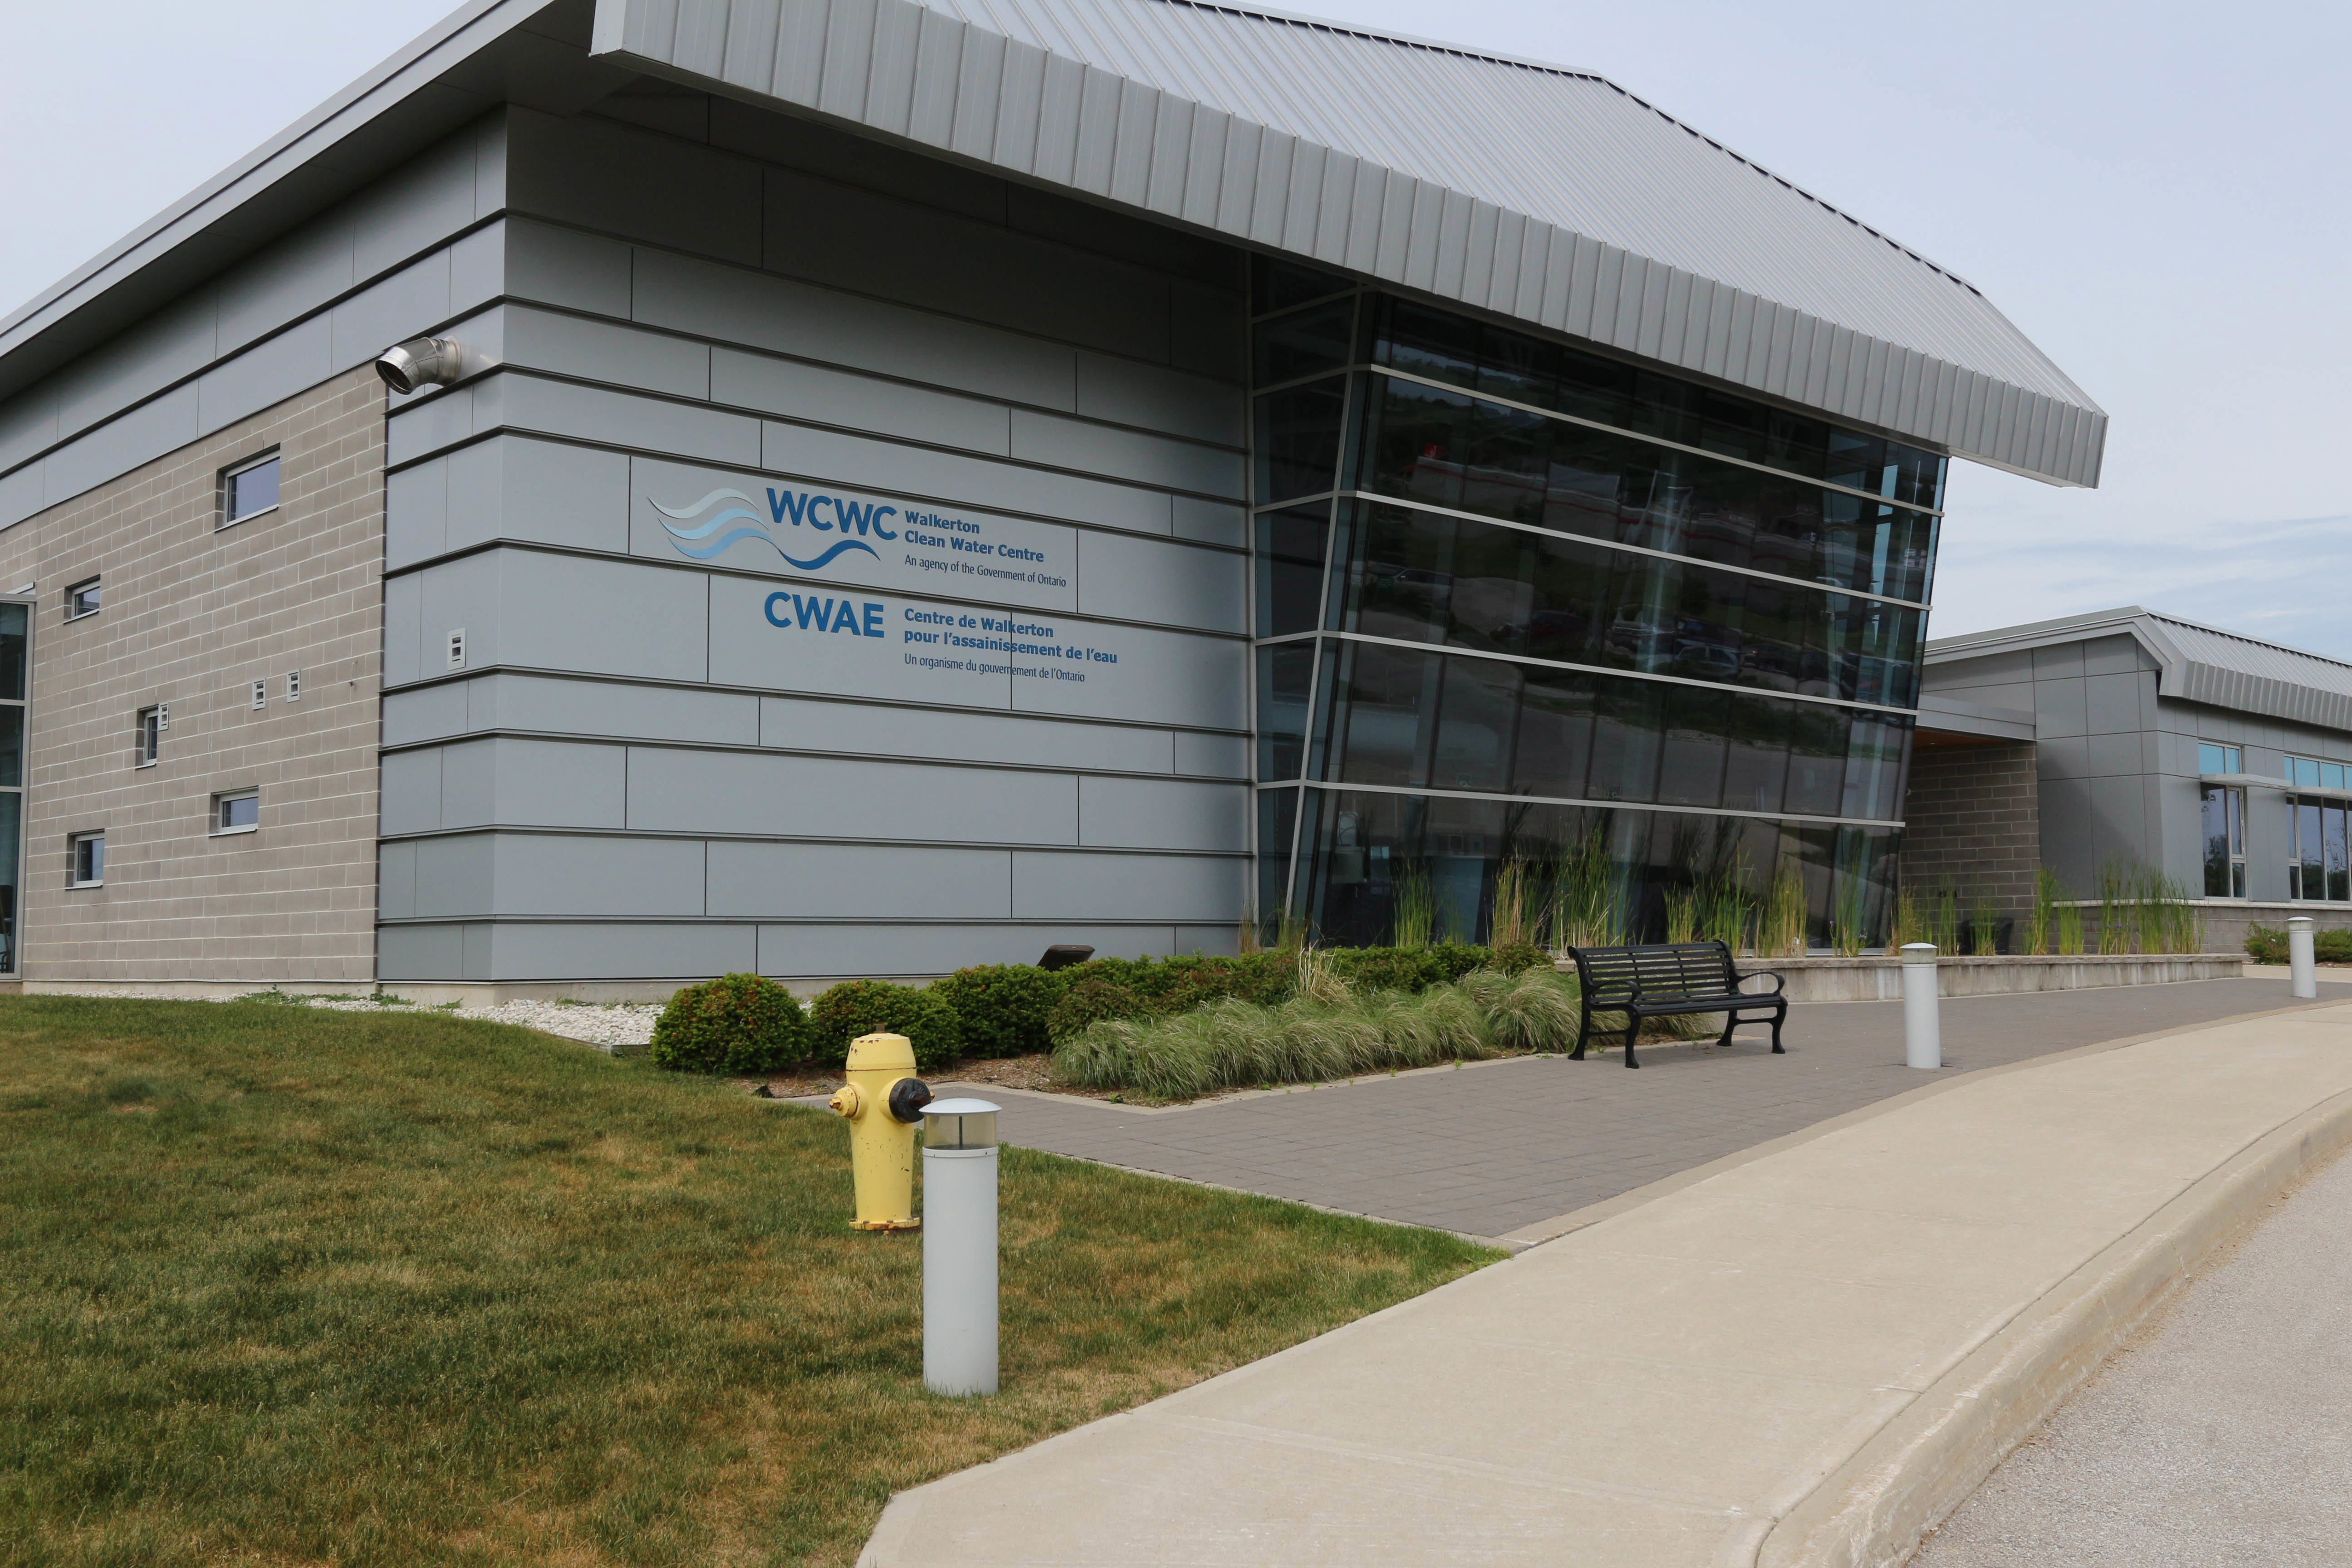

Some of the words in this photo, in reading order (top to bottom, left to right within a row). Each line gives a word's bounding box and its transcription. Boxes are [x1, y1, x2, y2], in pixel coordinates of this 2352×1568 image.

[766, 488, 897, 540] WCWC
[905, 510, 980, 534] Walkerton
[905, 530, 945, 547] Clean
[951, 537, 994, 554] Water
[998, 544, 1044, 562] Centre
[905, 554, 916, 566] An
[919, 558, 948, 573] agency
[951, 561, 960, 572] of
[962, 563, 975, 574] the
[977, 565, 1025, 582] Government
[1028, 572, 1036, 583] of
[1038, 574, 1066, 587] Ontario
[764, 592, 884, 638] CWAE
[905, 608, 954, 626] Centre
[959, 615, 976, 628] de
[981, 617, 1054, 637] Walkerton
[905, 630, 939, 643] pour
[944, 632, 1062, 657] l'assainissement
[1066, 647, 1082, 660] de
[1087, 648, 1117, 663] l'eau
[905, 653, 917, 665] Un
[920, 658, 963, 670] organisme
[966, 660, 976, 671] du
[979, 664, 1037, 677] gouvernement
[1039, 667, 1049, 679] de
[1051, 668, 1085, 682] l'Ontario
